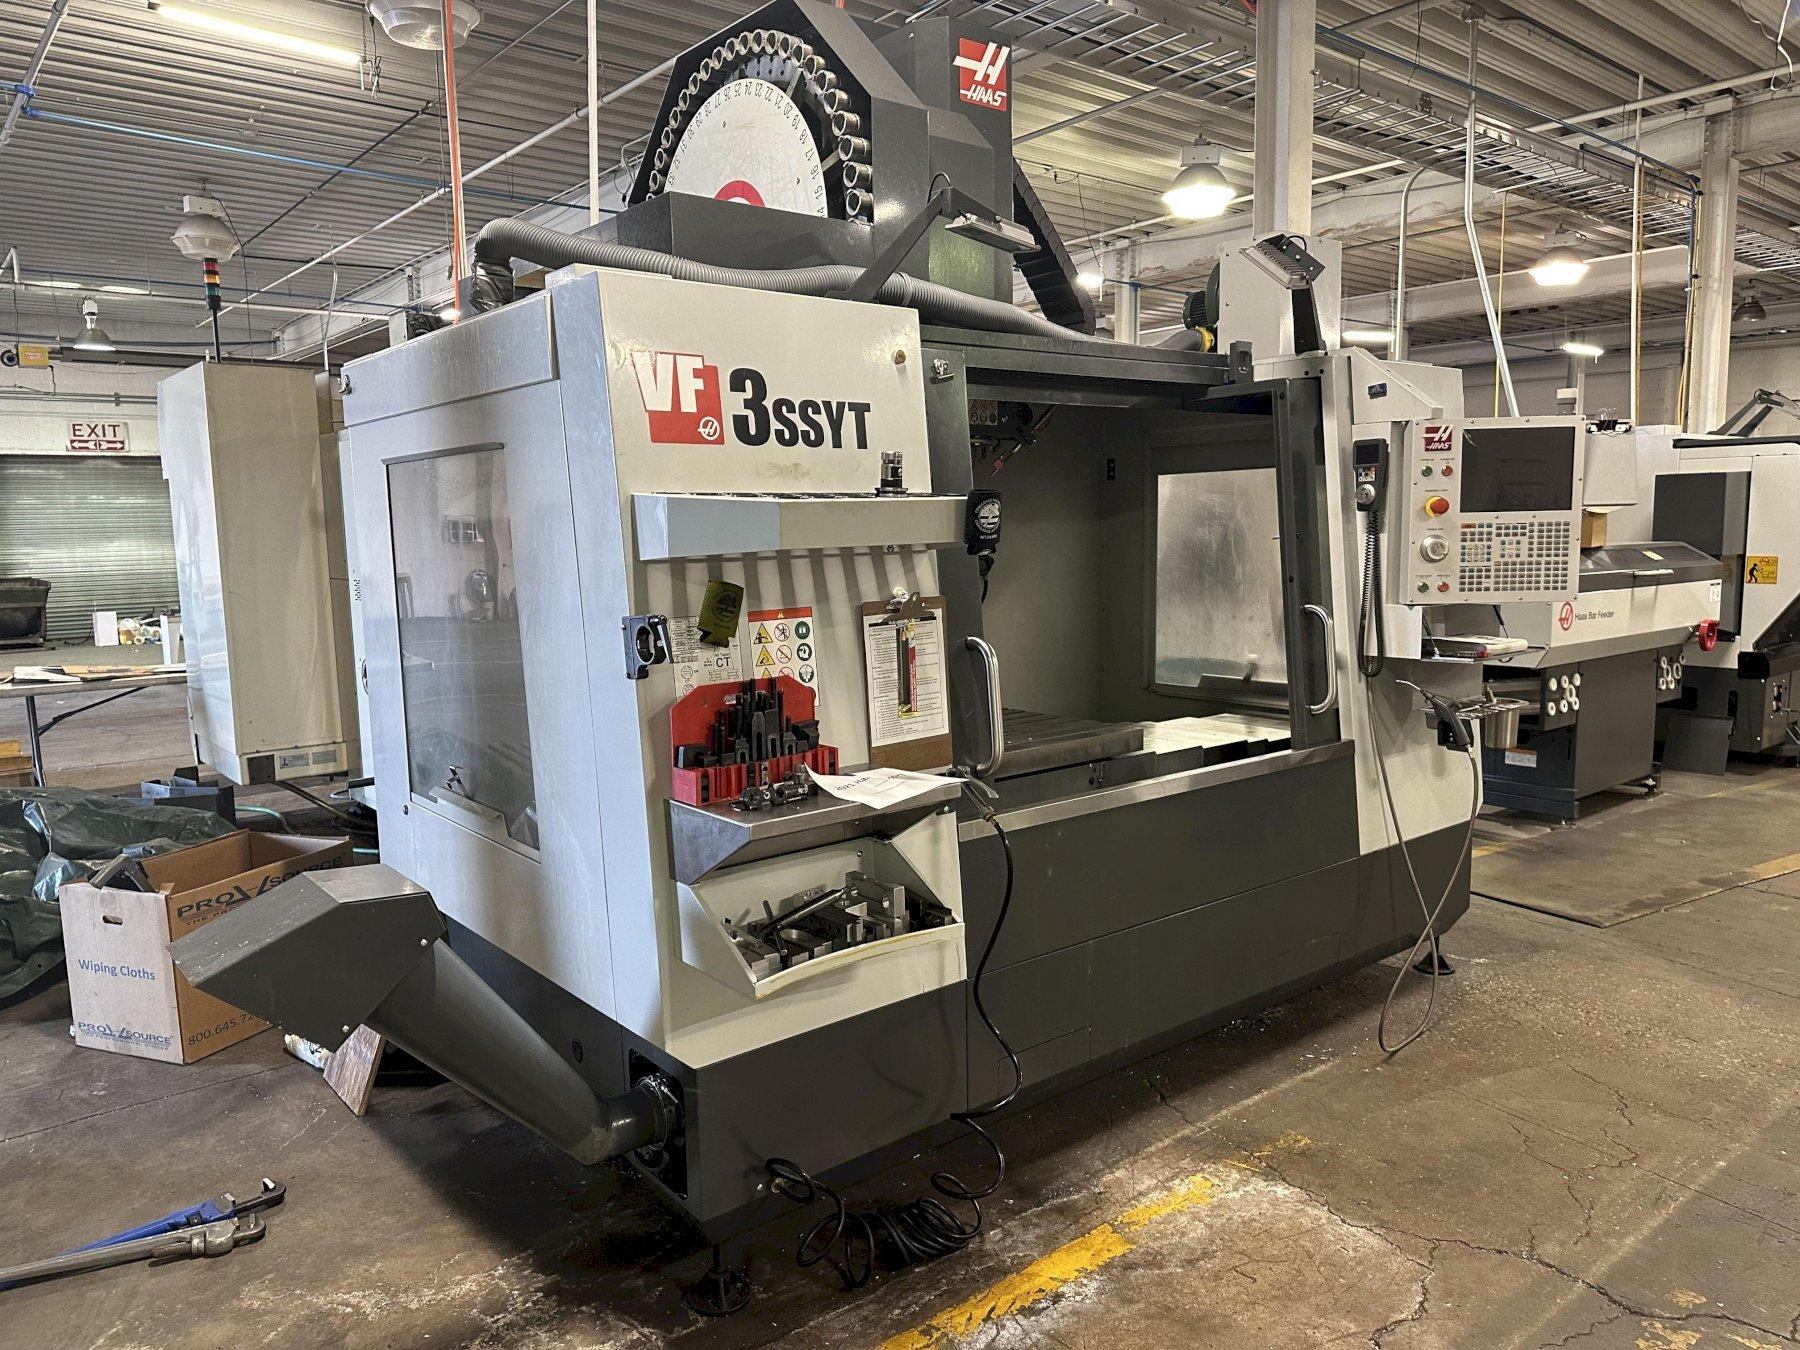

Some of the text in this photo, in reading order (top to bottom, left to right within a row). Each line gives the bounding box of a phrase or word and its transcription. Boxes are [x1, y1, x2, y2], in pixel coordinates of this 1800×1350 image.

[724, 86, 731, 101] 26
[734, 83, 741, 98] 25
[745, 82, 752, 95] 24
[755, 83, 762, 97] 23
[765, 87, 773, 101] 22
[960, 84, 1007, 106] HAAS
[775, 93, 784, 109] 21
[784, 103, 793, 119] 20
[792, 115, 800, 130] 19
[800, 129, 808, 144] 18
[805, 147, 815, 161] 17
[810, 165, 819, 180] 16
[815, 185, 823, 200] 15
[630, 351, 704, 413] VF
[71, 423, 120, 438] EXIT
[1574, 610, 1615, 620] Haas Bar Feeder
[716, 656, 731, 667] CT
[78, 959, 155, 981] Wiping Cloths
[125, 1030, 171, 1043] SOURCE
